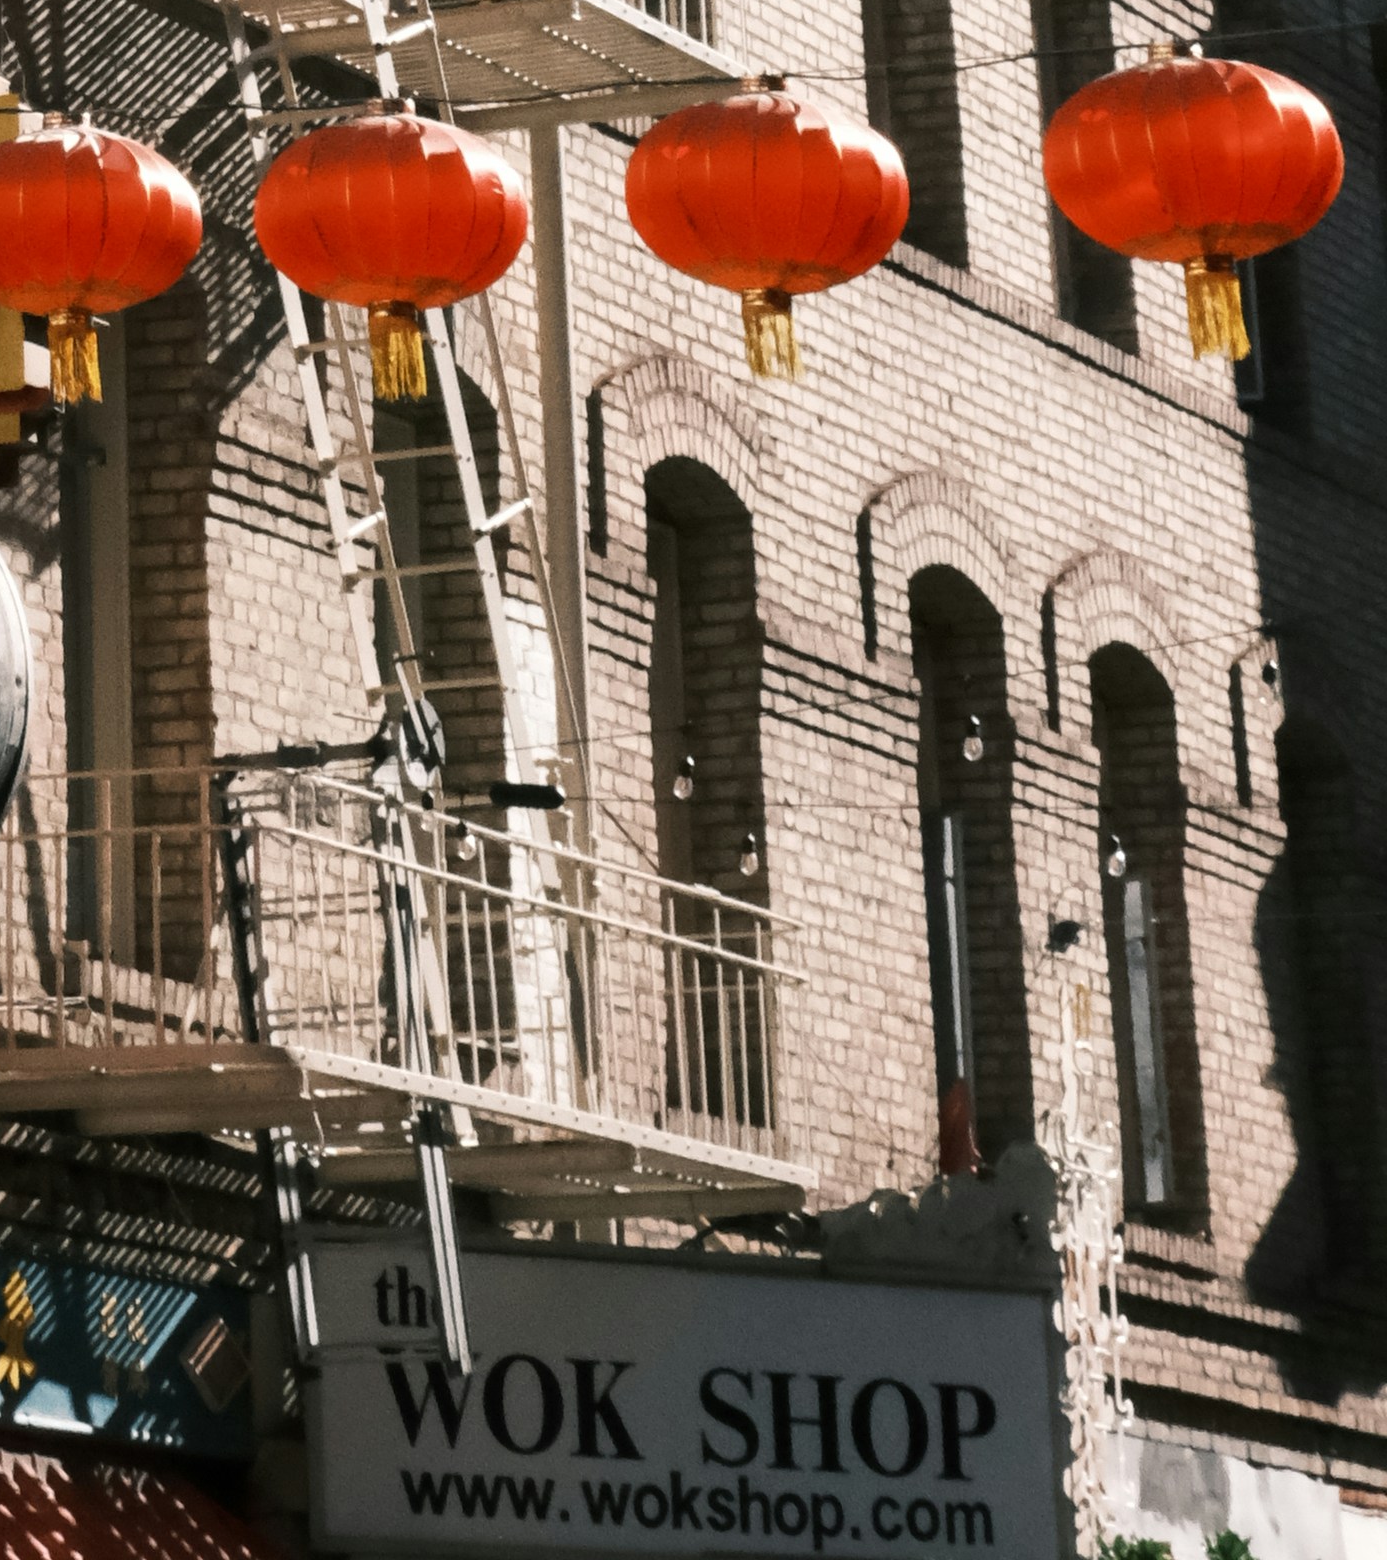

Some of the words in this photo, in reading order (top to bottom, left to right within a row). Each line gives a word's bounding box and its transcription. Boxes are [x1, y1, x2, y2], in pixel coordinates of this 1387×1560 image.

[372, 1264, 436, 1328] th
[379, 1347, 644, 1462] WOK
[698, 1365, 997, 1483] SHOP
[400, 1468, 996, 1549] www.wokshop.com
